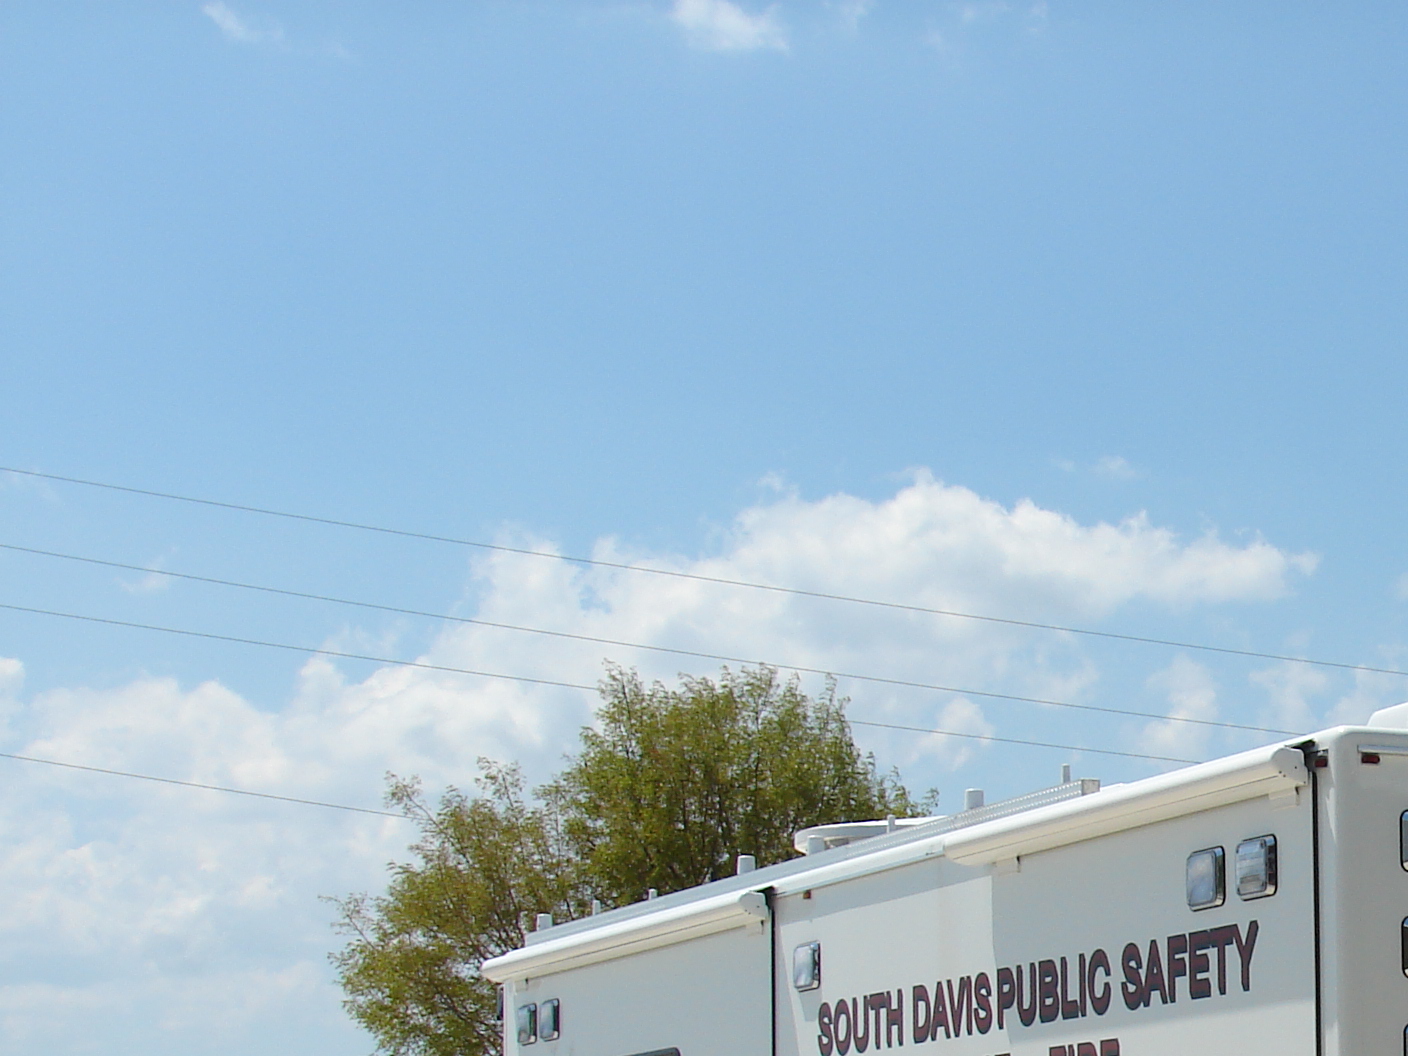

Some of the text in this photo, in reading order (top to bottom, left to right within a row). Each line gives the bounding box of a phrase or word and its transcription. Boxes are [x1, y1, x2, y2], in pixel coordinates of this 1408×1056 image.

[912, 972, 992, 1044] DAVIS
[997, 949, 1111, 1030] PUBLIC
[1121, 920, 1259, 1011] SAFETY
